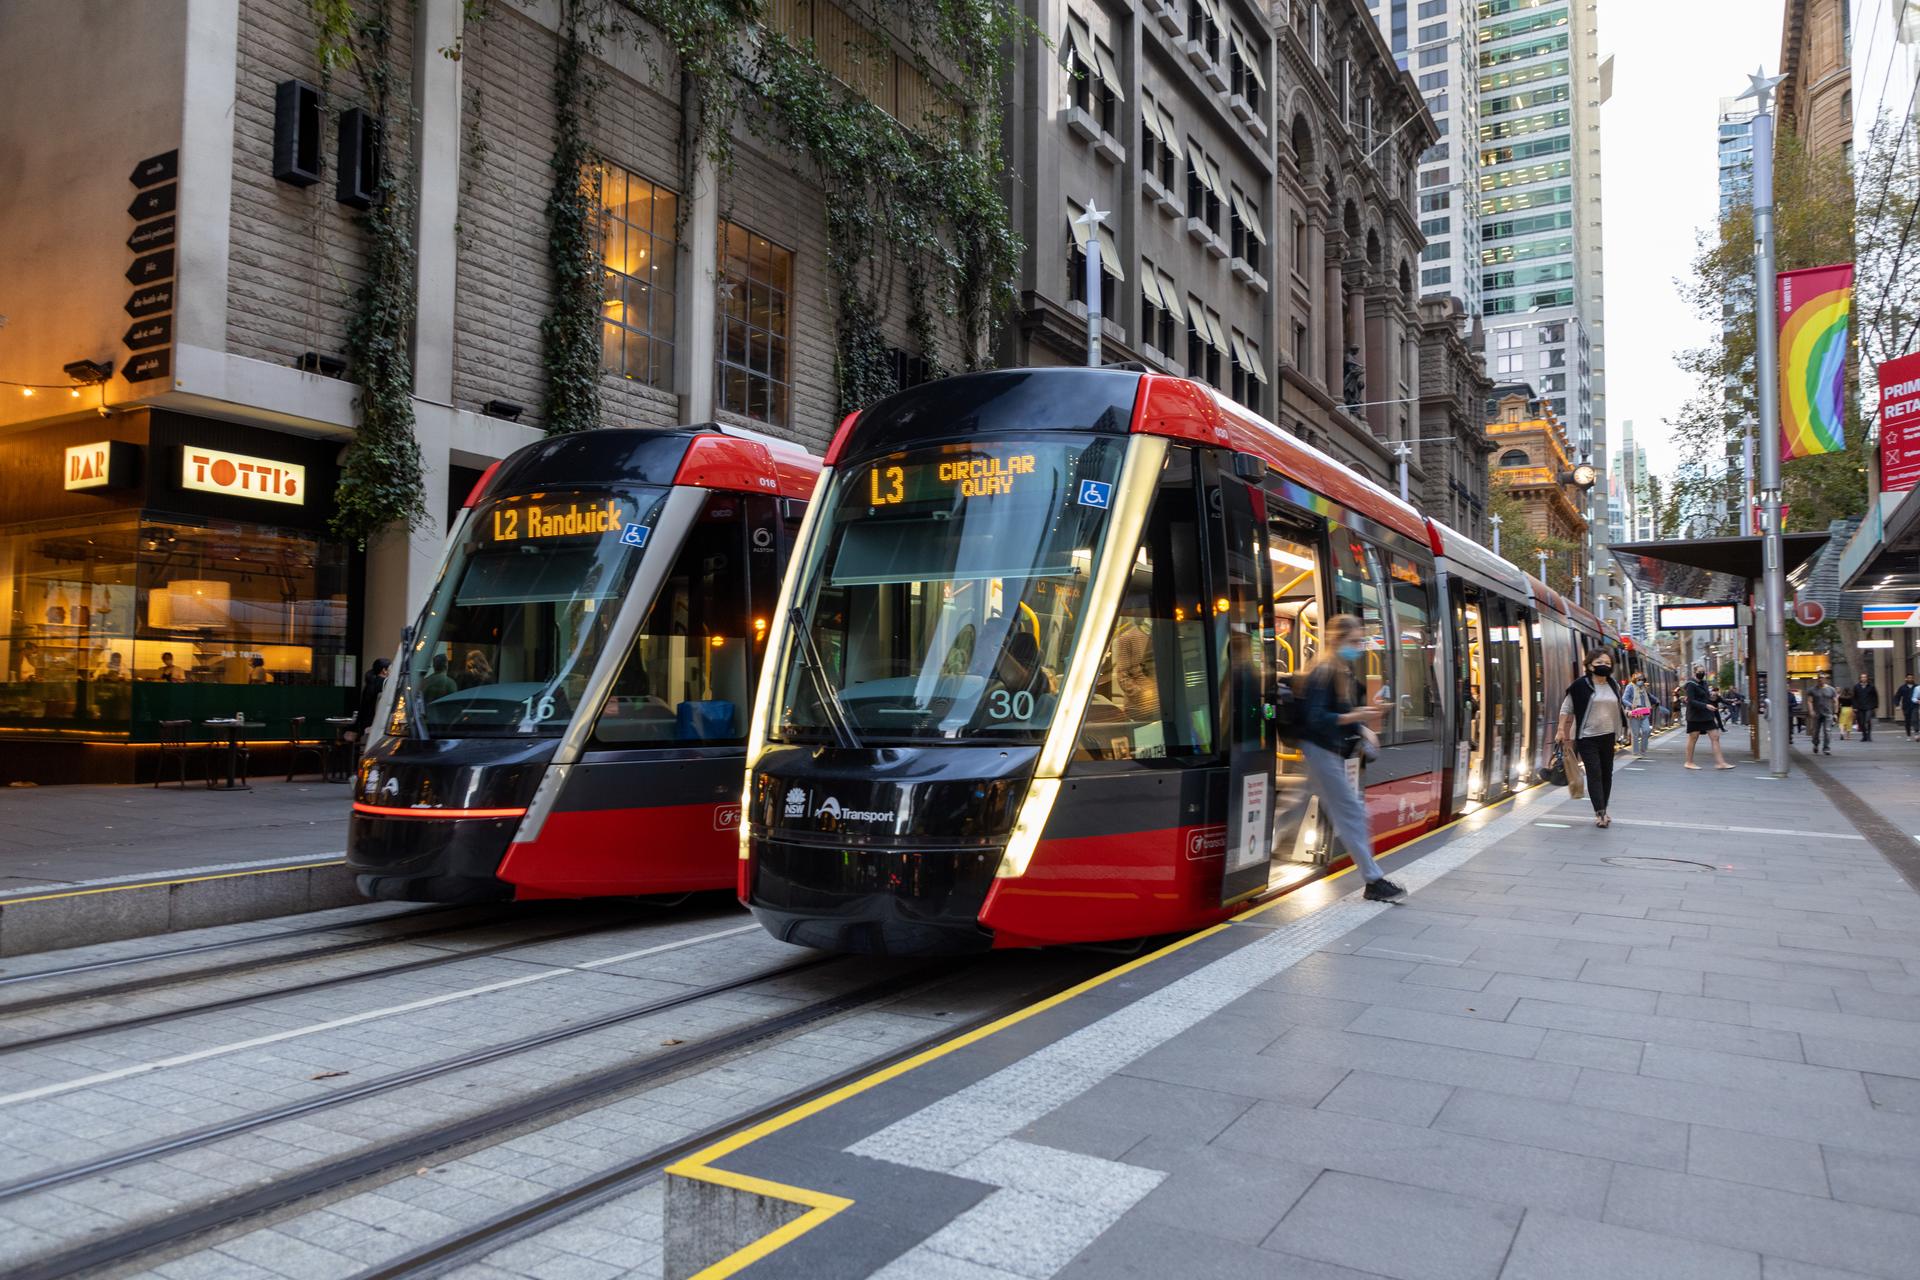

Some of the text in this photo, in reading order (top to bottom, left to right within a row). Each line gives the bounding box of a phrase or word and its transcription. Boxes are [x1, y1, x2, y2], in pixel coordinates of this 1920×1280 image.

[71, 451, 105, 482] BAR
[938, 454, 1036, 481] CIRCULAR
[759, 477, 776, 488] 016
[871, 466, 904, 505] L3
[961, 475, 1014, 497] QUAY
[494, 500, 622, 541] L2 Randwick
[1804, 606, 1816, 620] L
[521, 695, 555, 720] 16
[989, 689, 1034, 720] 30
[784, 804, 804, 814] NSW
[841, 808, 894, 823] Transport
